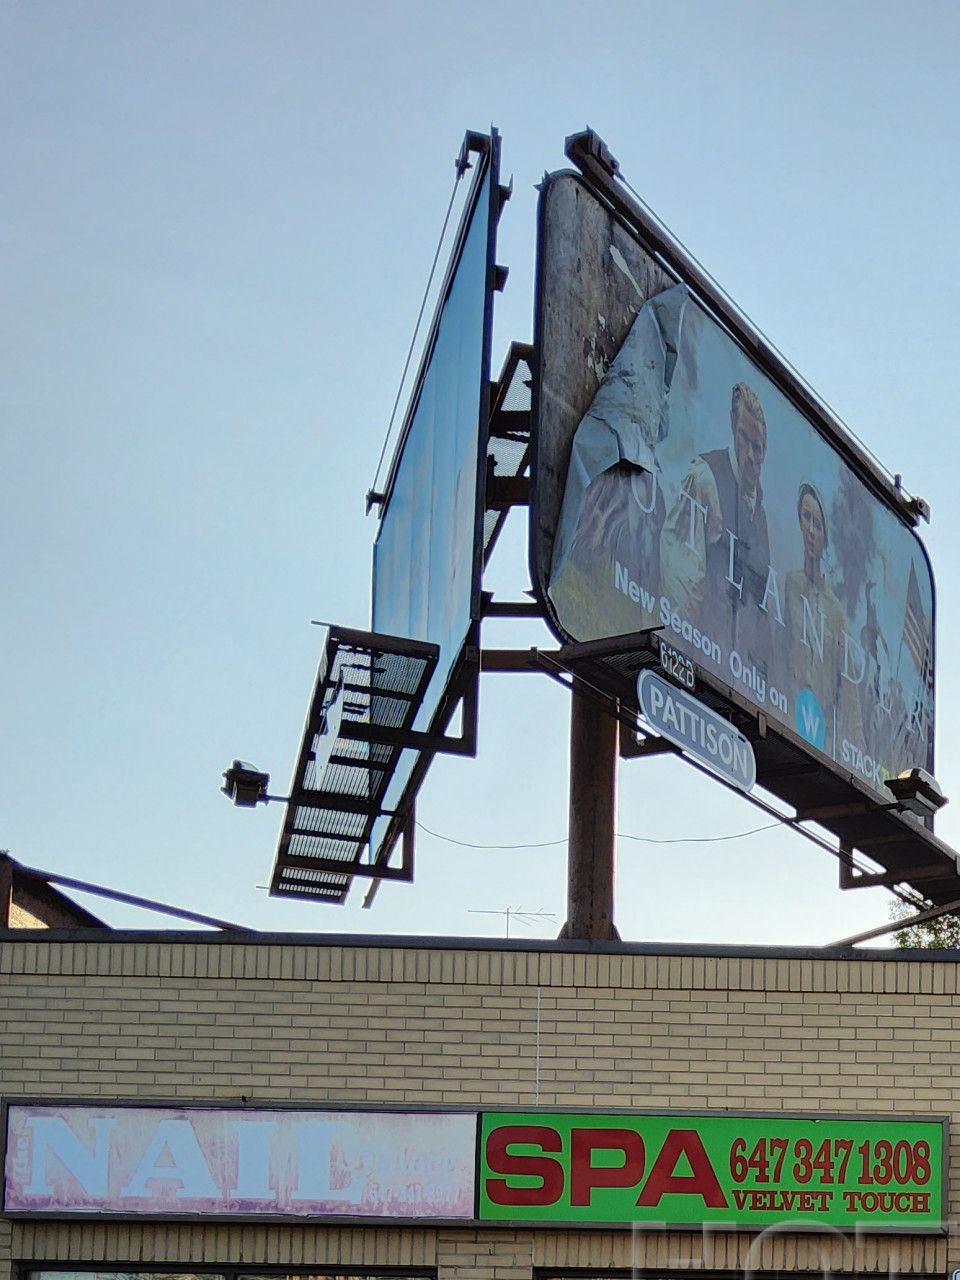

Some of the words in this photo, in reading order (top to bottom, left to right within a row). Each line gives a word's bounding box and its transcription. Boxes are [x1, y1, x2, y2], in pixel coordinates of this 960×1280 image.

[614, 561, 655, 614] New
[659, 596, 722, 665] Season
[728, 650, 767, 703] Only
[769, 690, 789, 714] on
[632, 463, 927, 742] UTLANDER
[650, 684, 748, 779] PATTISON
[801, 704, 820, 740] W
[485, 1125, 729, 1208] SPA
[729, 1137, 789, 1184] 647
[793, 1138, 854, 1185] 347
[858, 1139, 931, 1186] 1308
[732, 1190, 832, 1212] VELVET
[843, 1192, 931, 1213] TOUCH
